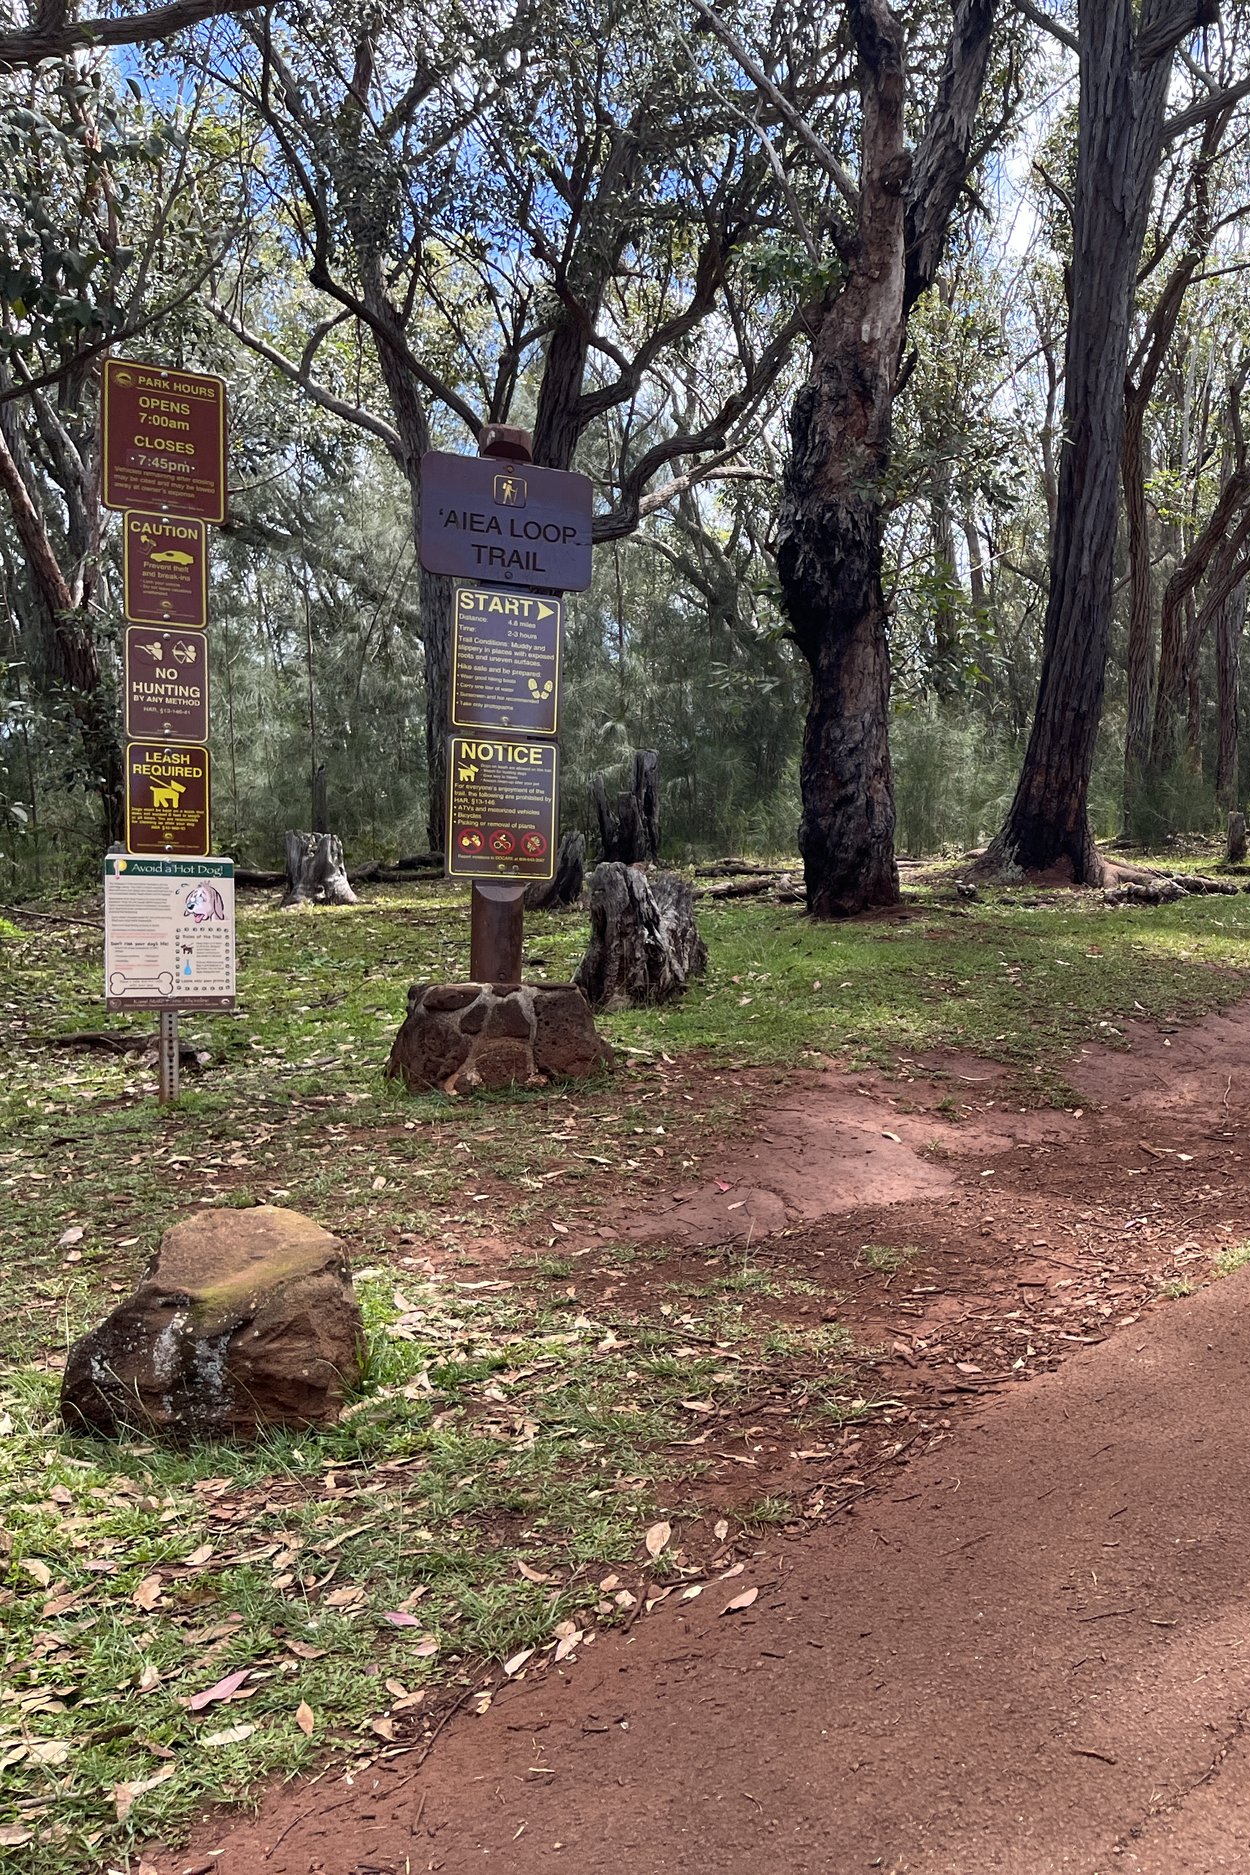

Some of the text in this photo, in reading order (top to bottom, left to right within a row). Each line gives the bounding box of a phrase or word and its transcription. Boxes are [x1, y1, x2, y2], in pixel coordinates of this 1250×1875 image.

[138, 376, 215, 398] PARK HOURS
[139, 396, 190, 415] OPENS
[139, 413, 190, 431] 7:00am
[134, 435, 195, 455] CLOSES
[138, 455, 190, 473] 7:45pm
[130, 521, 198, 540] CAUTION
[510, 518, 576, 545] LOOP
[144, 561, 171, 570] Prevent
[471, 544, 546, 572] TRAIL
[158, 572, 190, 581] break-ins
[460, 592, 533, 616] START
[458, 644, 483, 653] slippery
[511, 642, 532, 651] Muddy
[155, 667, 178, 680] NO
[132, 682, 200, 698] HUNTING
[165, 698, 200, 706] METHOD
[146, 752, 190, 764] LEASH
[461, 742, 543, 764] NOTICE
[133, 764, 202, 778] REQUIRED
[131, 862, 162, 872] Avoid
[174, 864, 194, 874] Hot
[197, 865, 223, 877] Dog!
